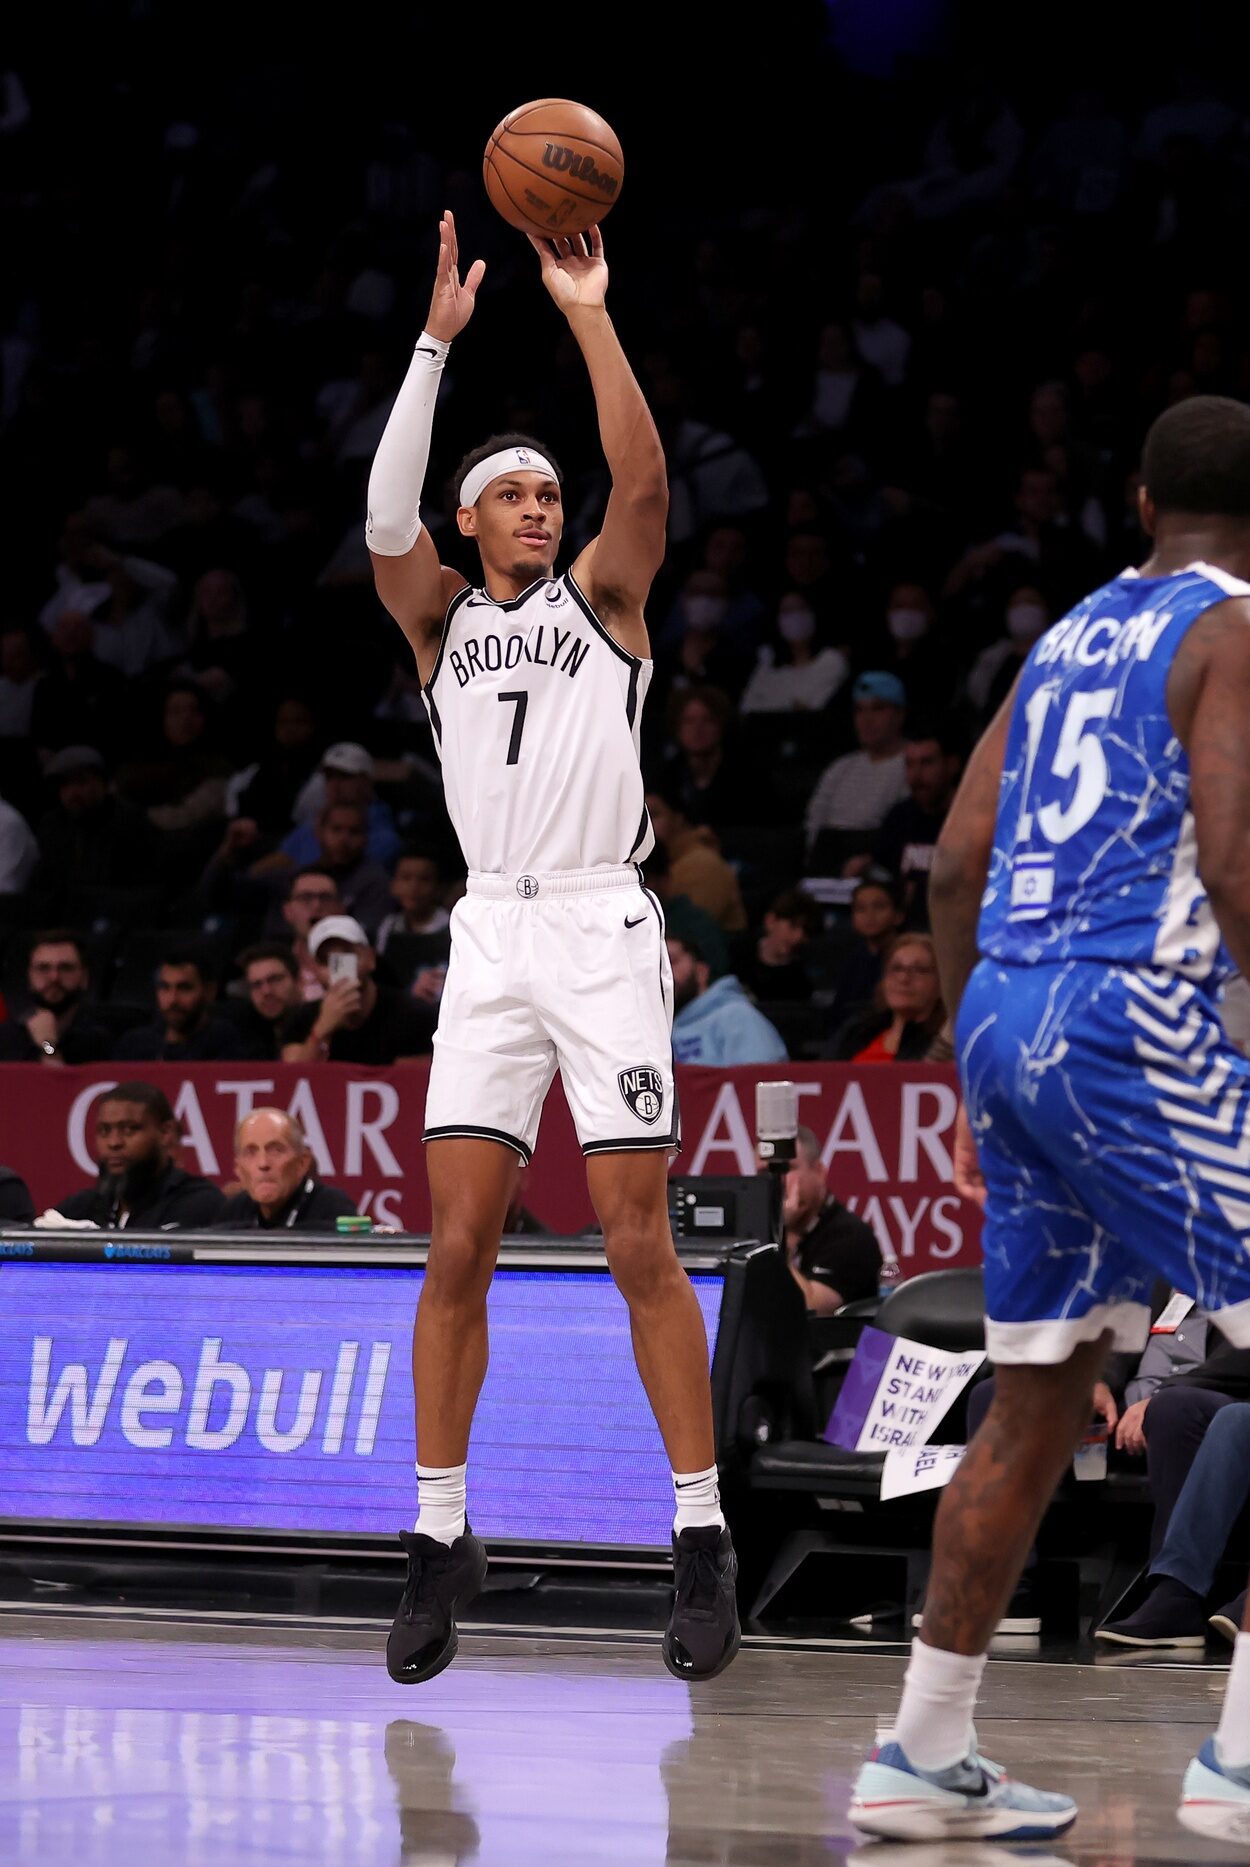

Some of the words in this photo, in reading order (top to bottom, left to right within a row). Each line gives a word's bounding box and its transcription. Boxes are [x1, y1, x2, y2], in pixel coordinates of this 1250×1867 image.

[542, 142, 618, 197] Wilson
[498, 691, 528, 765] 7
[1016, 679, 1118, 844] 15
[622, 1069, 663, 1095] NETS
[668, 1081, 957, 1182] AAR
[26, 1336, 392, 1455] Webull
[896, 1355, 946, 1380] NEW
